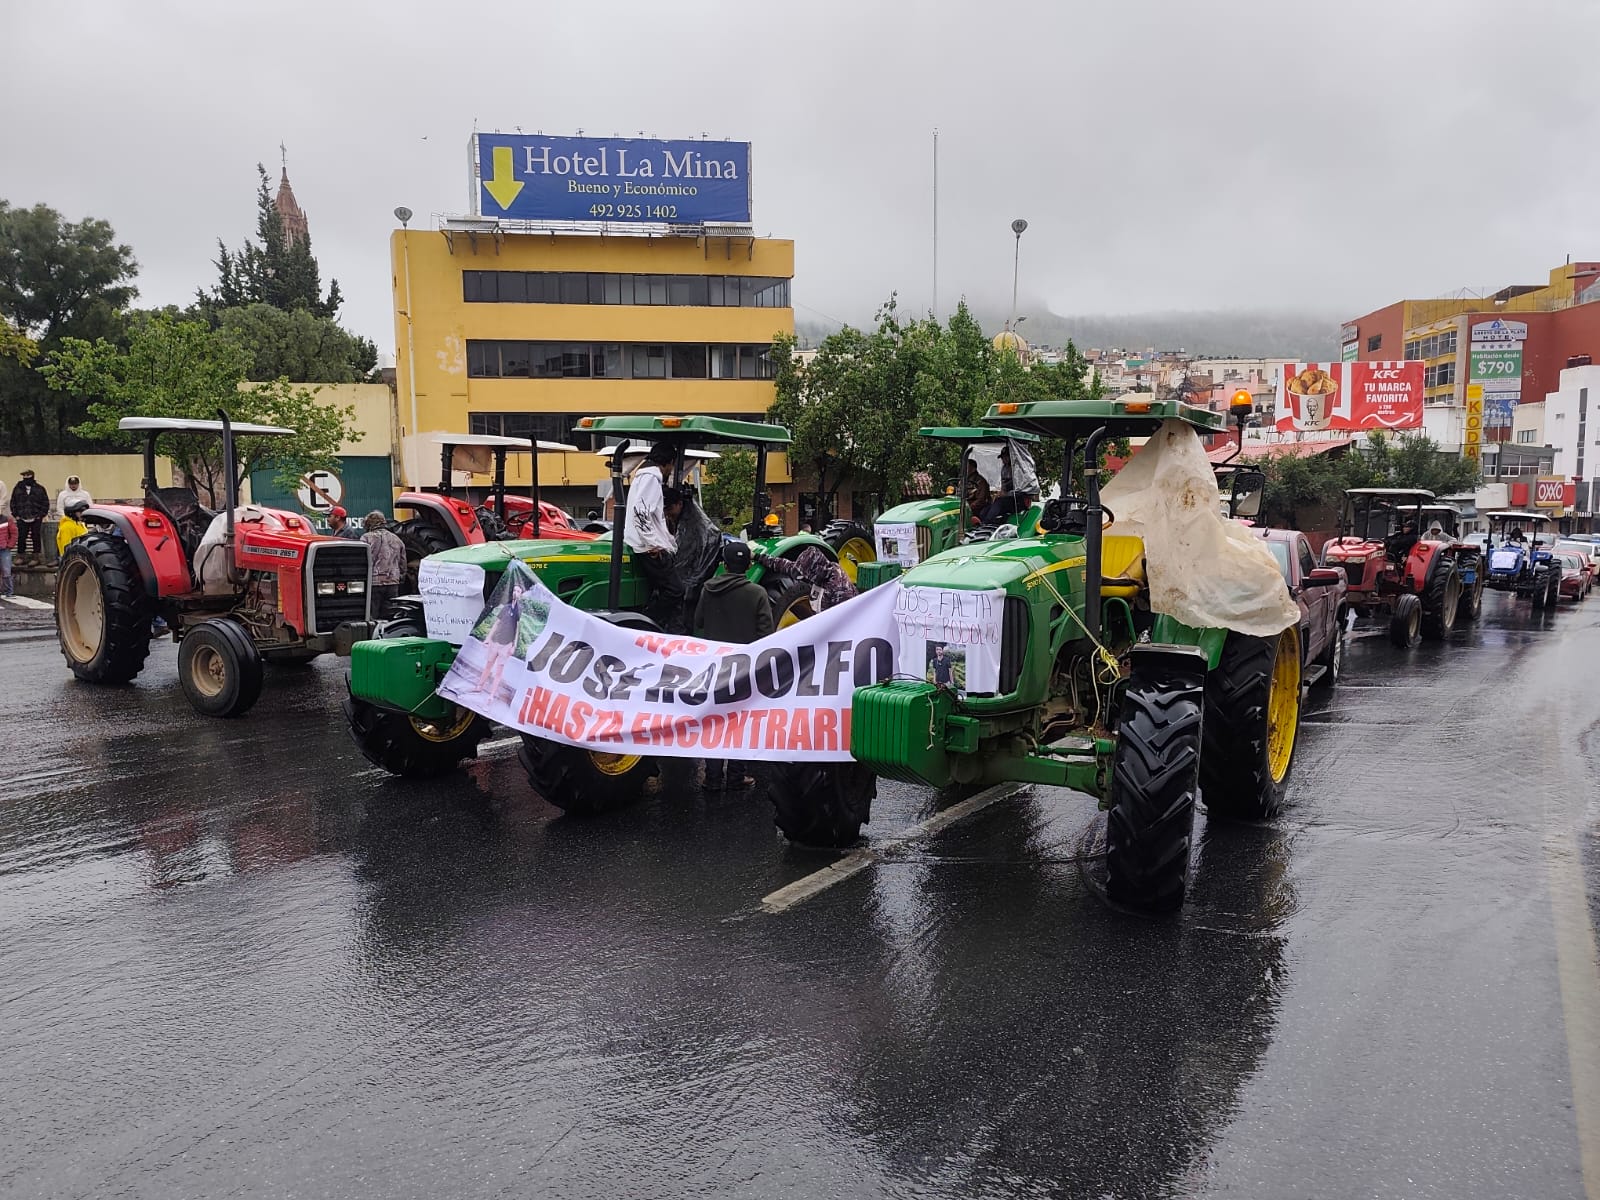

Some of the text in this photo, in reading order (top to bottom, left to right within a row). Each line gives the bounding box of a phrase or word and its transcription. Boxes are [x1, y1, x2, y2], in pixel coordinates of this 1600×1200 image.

[523, 145, 738, 180] Hotel La Mina
[568, 179, 698, 198] Bueno y Económico
[589, 203, 678, 219] 492 925 1402
[1372, 370, 1401, 379] KFC
[1477, 360, 1515, 376] $790
[1364, 382, 1412, 392] TU MARCA
[1366, 393, 1409, 403] FAVORITA
[1467, 400, 1480, 458] KODA
[1538, 483, 1564, 502] OXXO
[527, 631, 894, 706] JOSÉ RODOLFO
